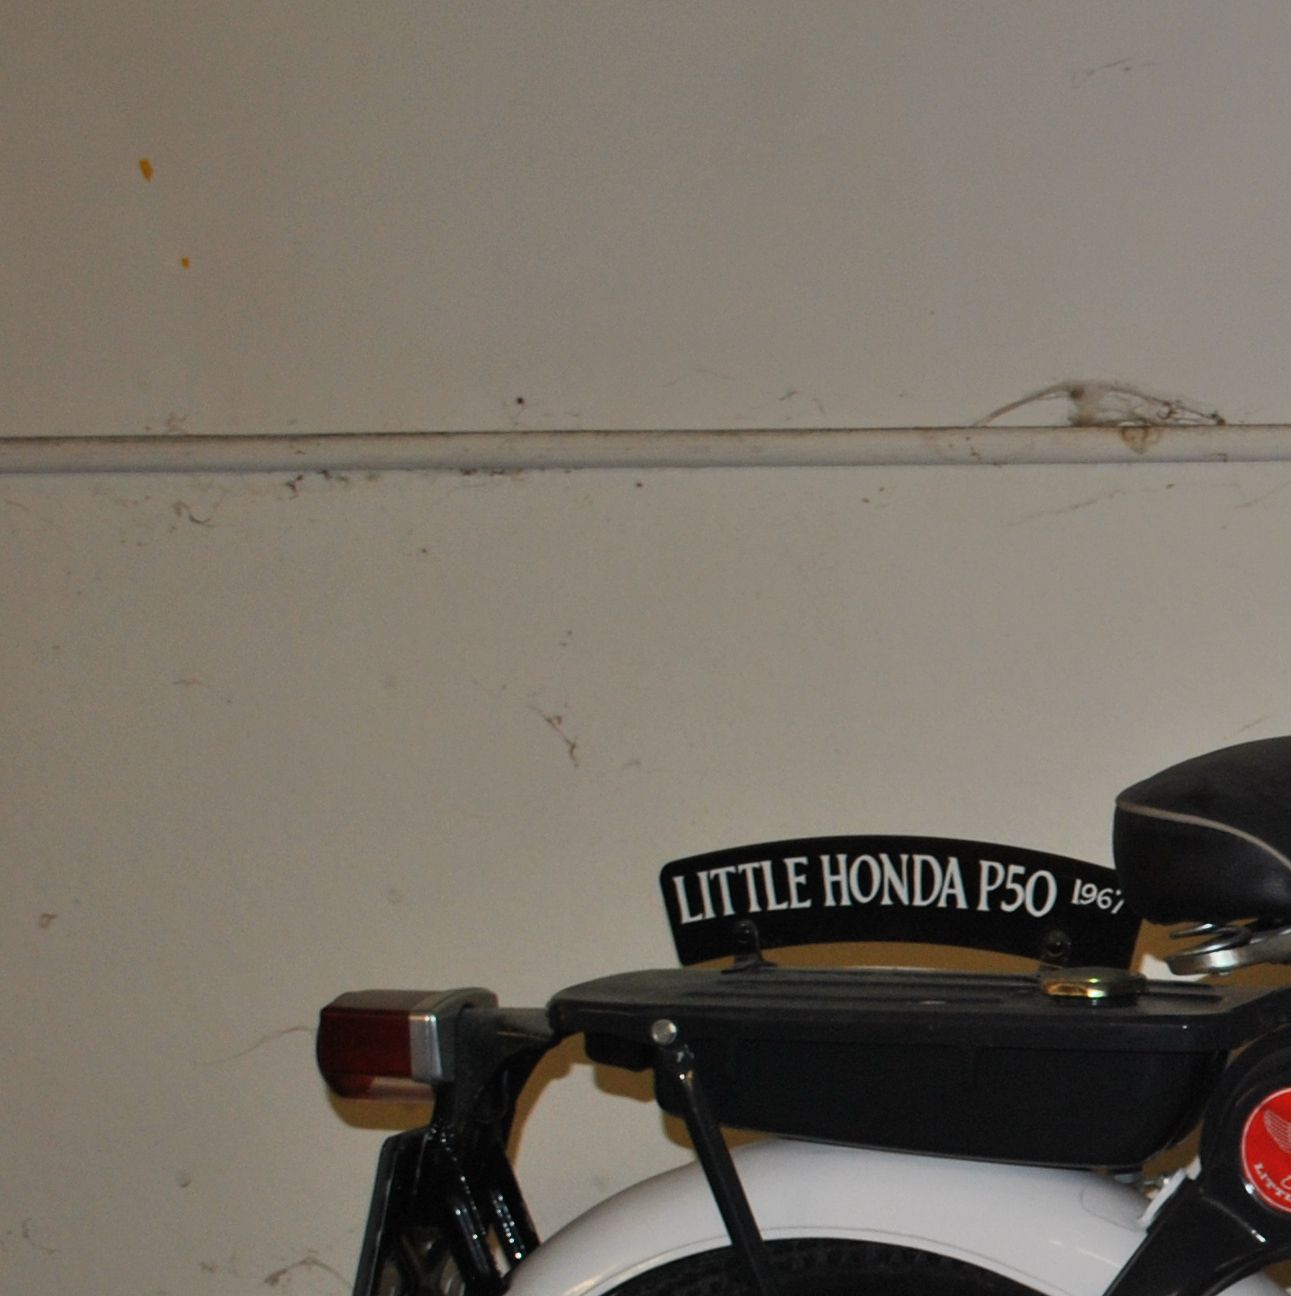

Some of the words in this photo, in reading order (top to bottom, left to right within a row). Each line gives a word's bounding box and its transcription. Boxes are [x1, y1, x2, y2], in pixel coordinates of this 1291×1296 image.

[672, 856, 811, 924] LITTLE
[819, 853, 968, 910] HONDA
[976, 860, 1058, 918] P50
